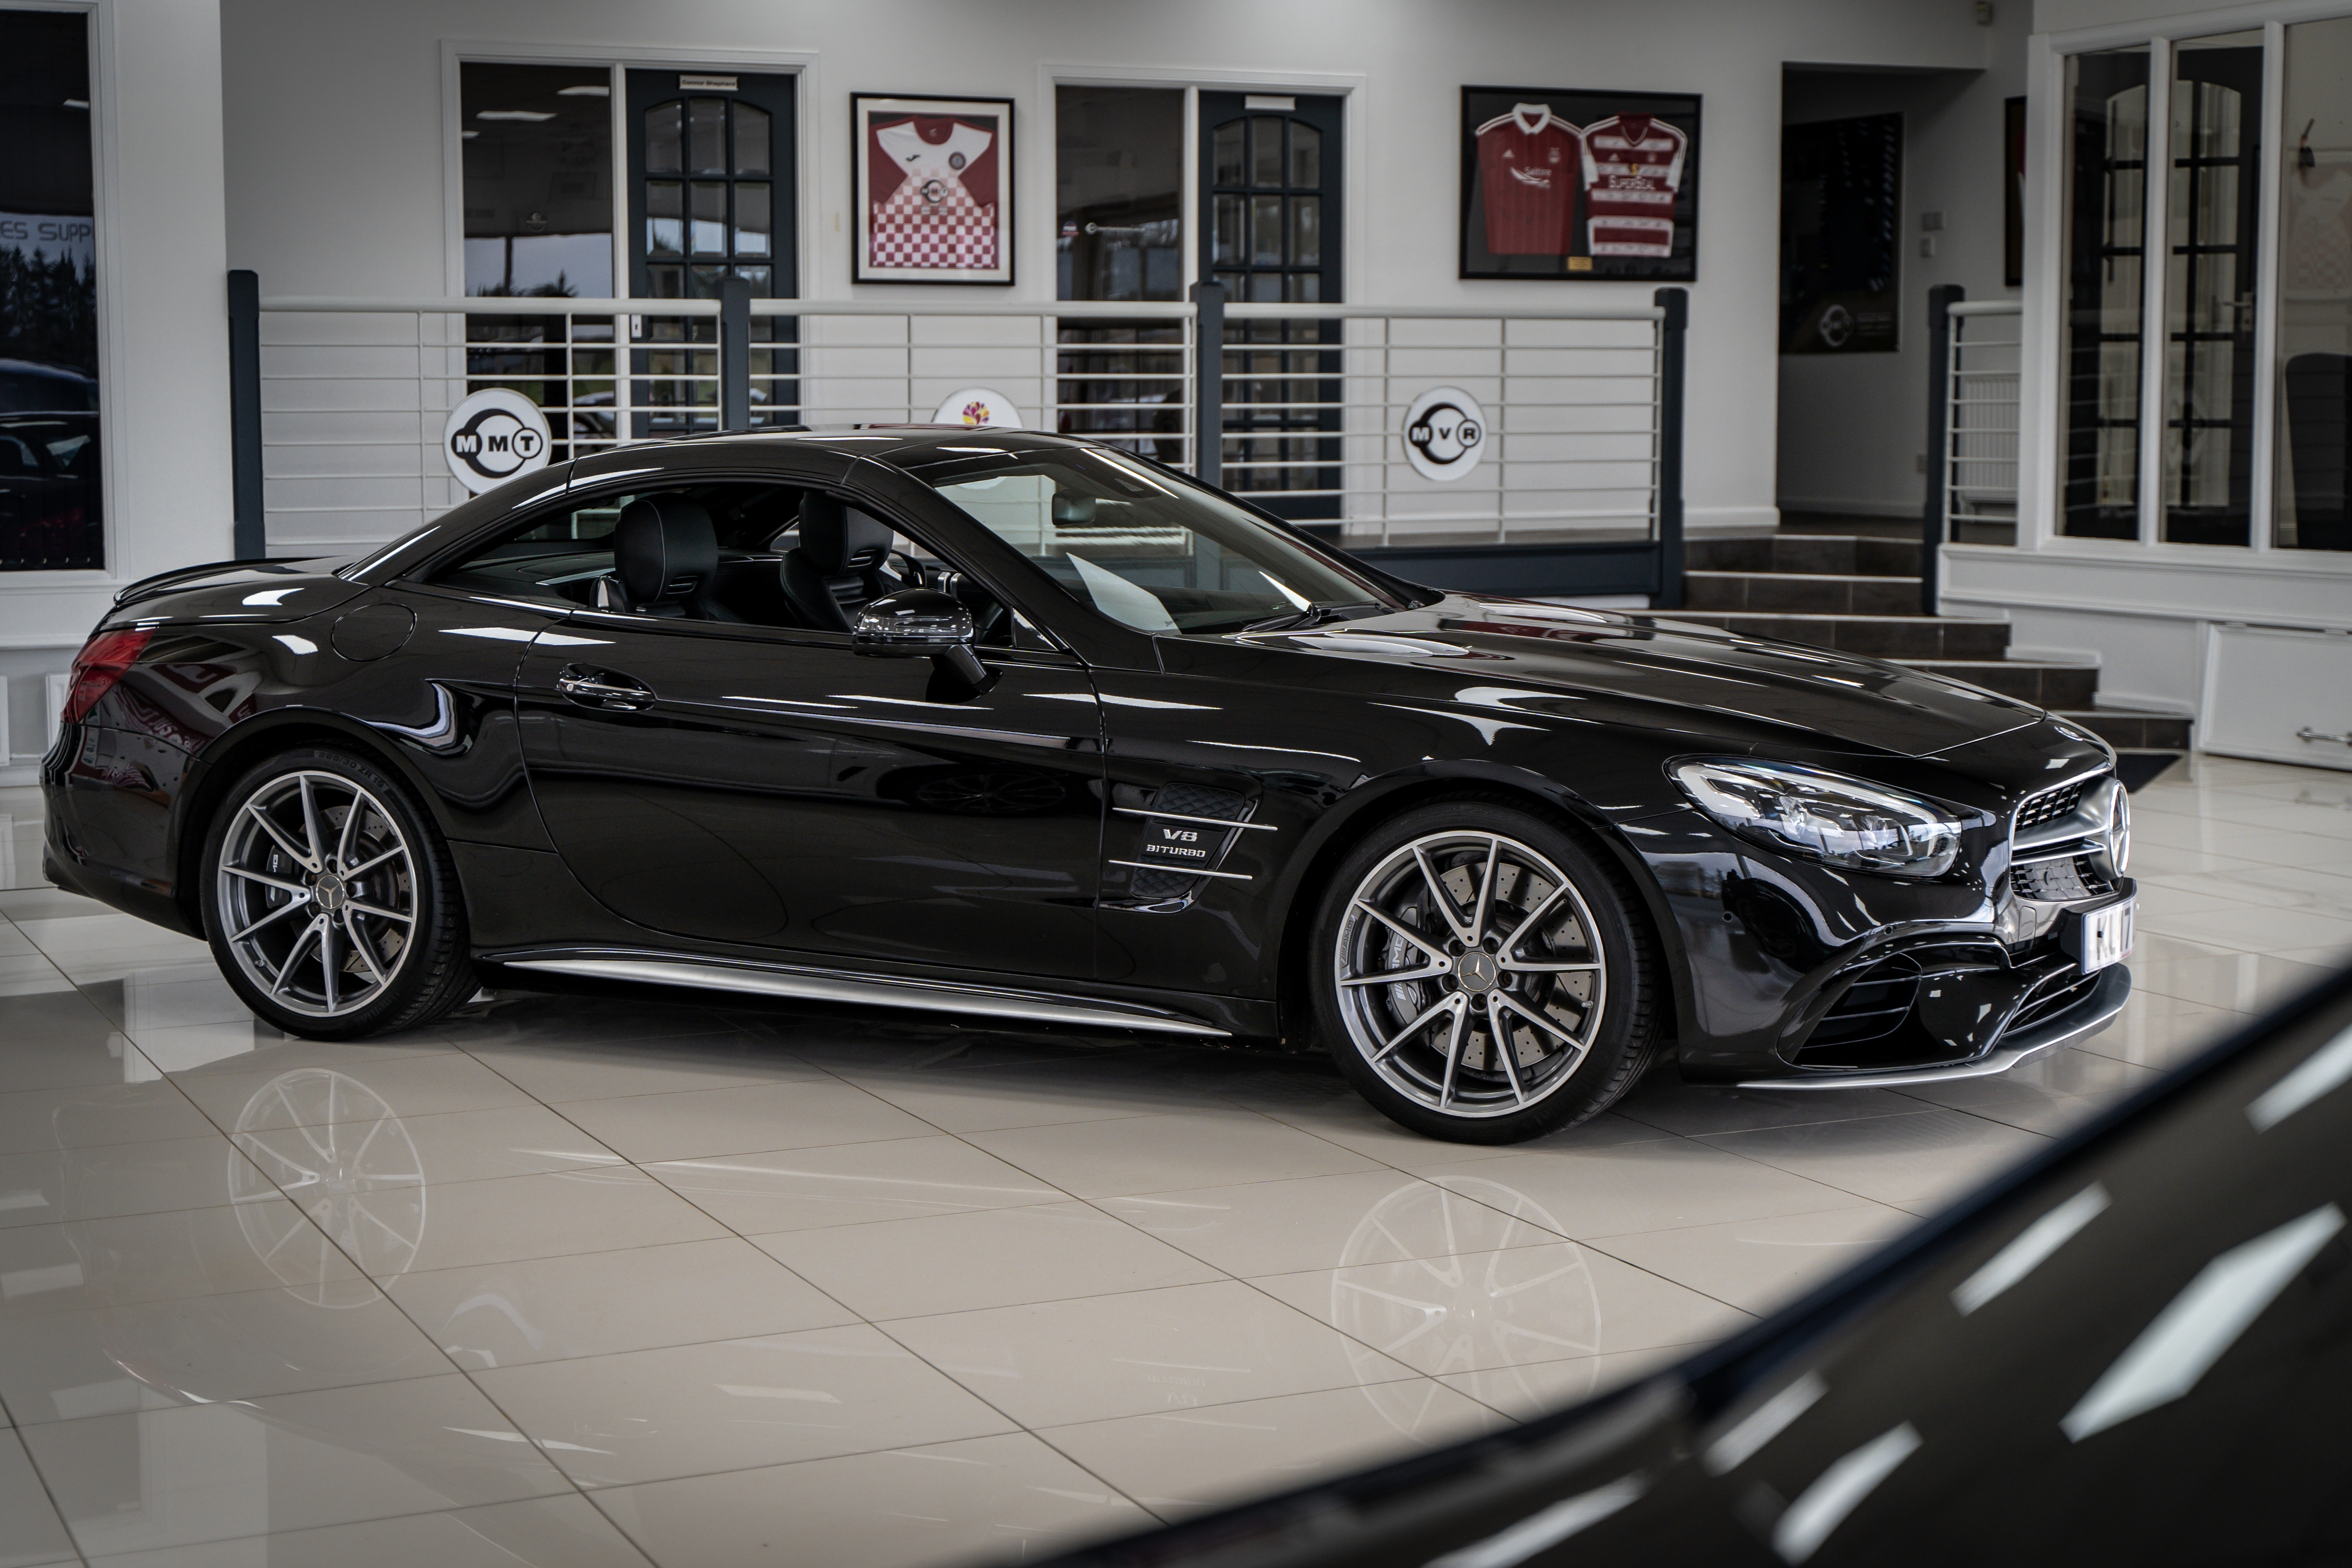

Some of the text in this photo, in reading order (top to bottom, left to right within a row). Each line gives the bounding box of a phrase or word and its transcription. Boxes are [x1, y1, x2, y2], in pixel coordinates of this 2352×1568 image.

[358, 767, 372, 779] ZR
[374, 777, 384, 788] 19
[1163, 829, 1198, 842] V8
[1146, 844, 1206, 857] BITURBO
